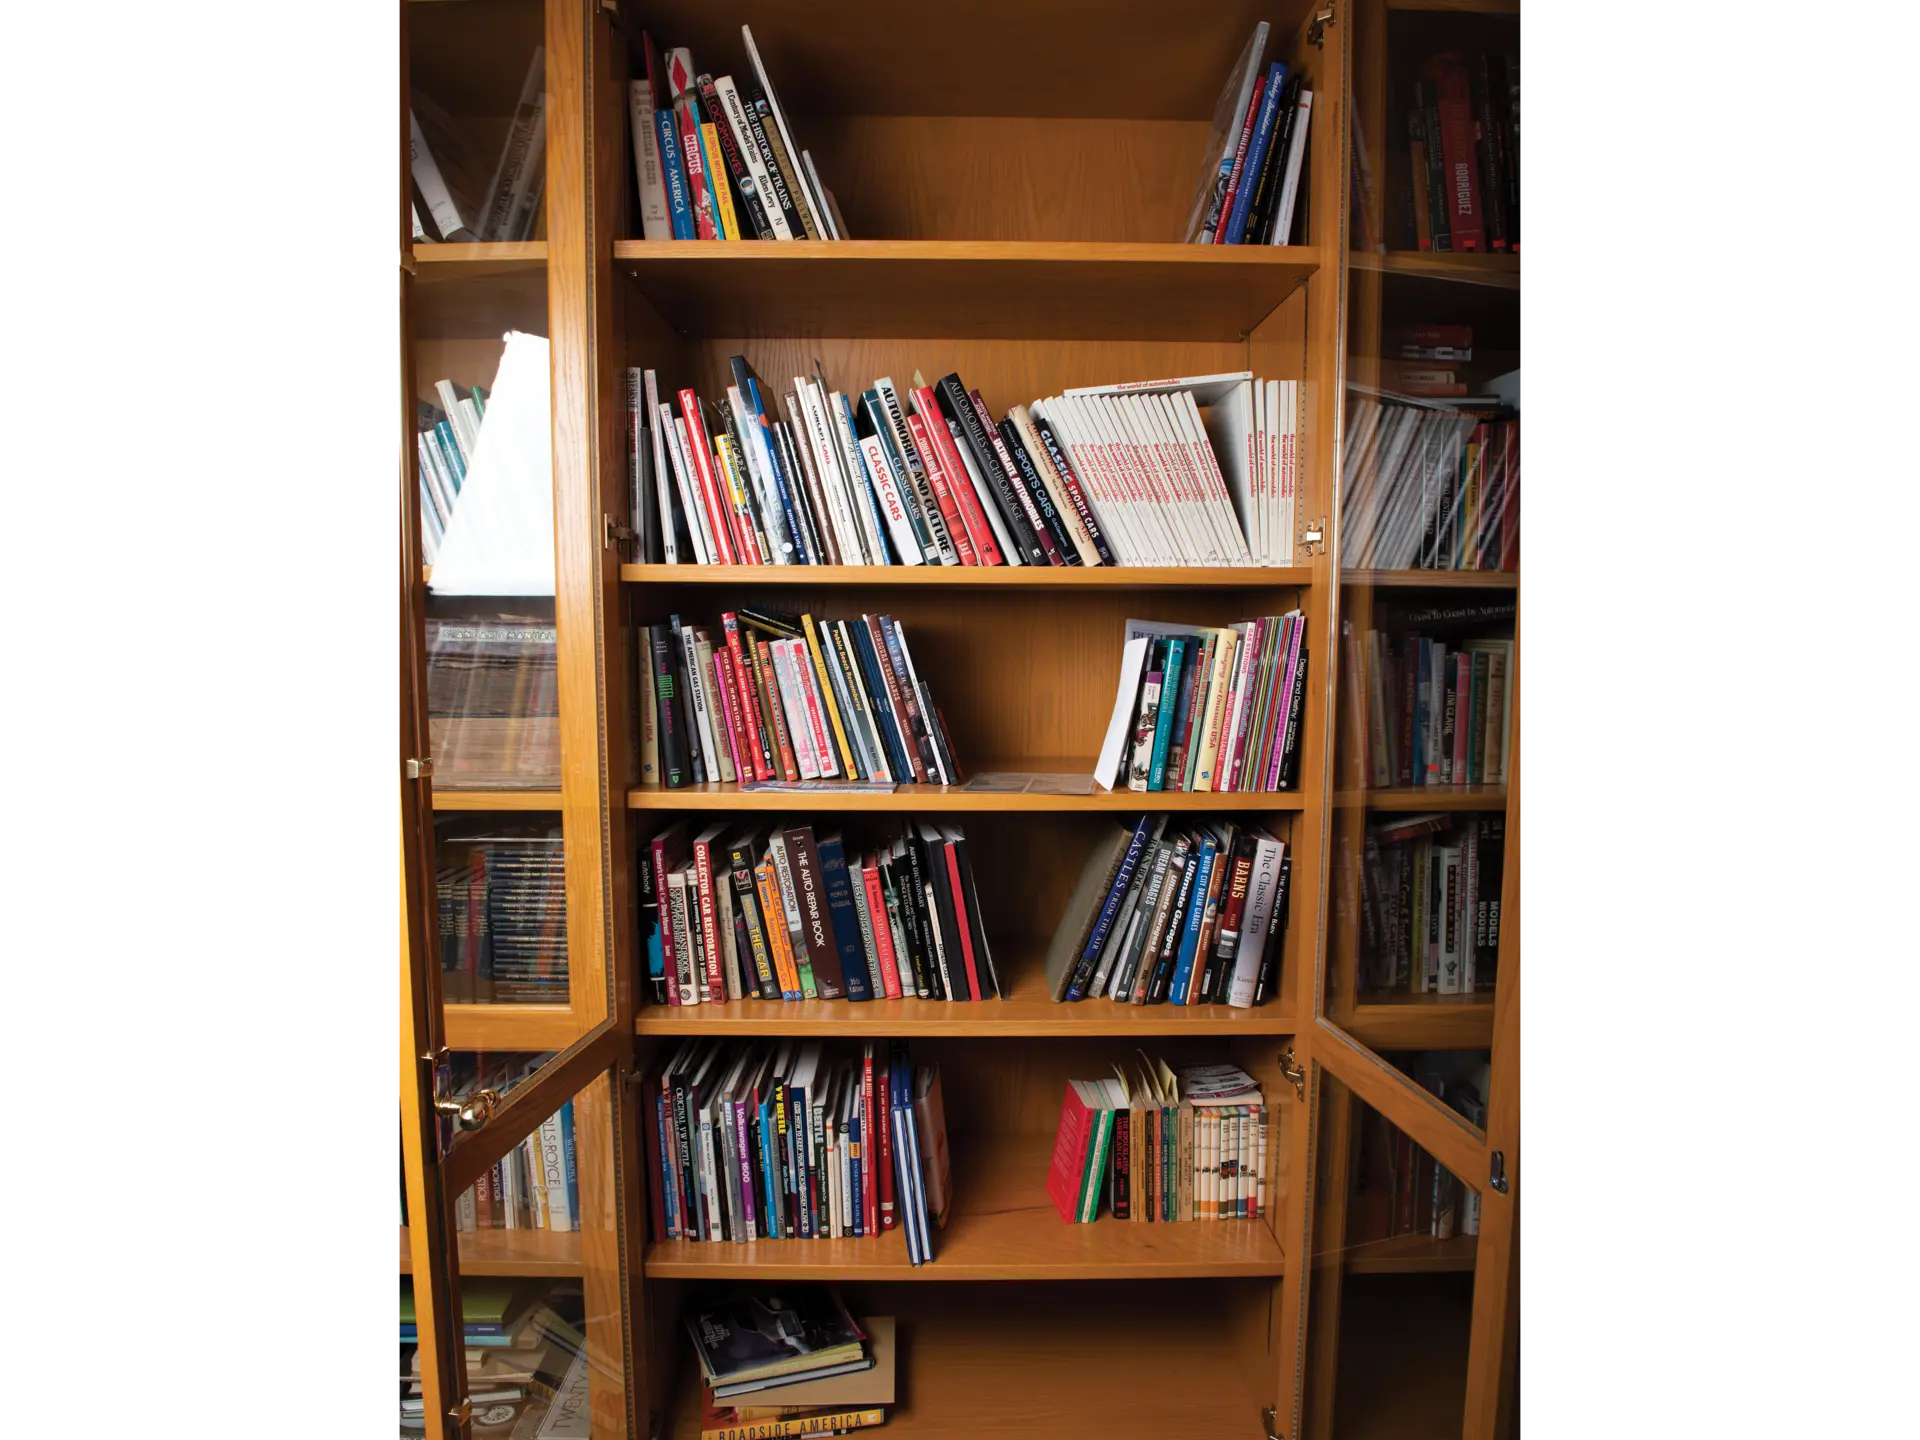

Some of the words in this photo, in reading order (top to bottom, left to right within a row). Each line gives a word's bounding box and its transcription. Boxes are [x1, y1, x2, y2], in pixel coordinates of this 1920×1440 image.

[726, 93, 742, 119] Century
[743, 101, 757, 123] THE
[706, 124, 714, 136] THE
[736, 117, 745, 126] of
[738, 124, 752, 145] Model
[706, 98, 743, 175] LOCOMOTIVES
[708, 136, 719, 159] CIRCUS
[751, 122, 773, 161] HISTORY
[661, 120, 675, 158] CIRCUS
[668, 167, 684, 213] AMERICA
[682, 133, 701, 175] CIRCUS
[746, 143, 760, 163] Trains
[766, 160, 778, 175] OF
[1226, 127, 1250, 193] HARLEY-DAVIDSON
[713, 159, 724, 181] MOVES
[758, 174, 770, 192] Allen
[718, 181, 726, 191] BY
[720, 191, 729, 204] RAIL
[763, 191, 776, 209] Levy
[771, 172, 792, 210] TRAINS
[1454, 162, 1472, 215] RODRÍGUEZ
[792, 189, 813, 232] PULLMAN
[1148, 379, 1180, 387] automobiles
[724, 416, 735, 438] Beauty
[811, 404, 824, 441] CONCEPT
[821, 443, 831, 464] CARS
[730, 438, 738, 446] of
[948, 379, 988, 448] AUTOMOBILES
[987, 458, 1015, 503] CHROME
[1008, 500, 1024, 520] AGE
[732, 446, 745, 471] CARS
[880, 384, 920, 468] AUTOMOBILE
[911, 468, 929, 496] AND
[922, 497, 951, 554] CULTURE
[867, 444, 891, 491] CLASSIC
[883, 490, 902, 521] CARS
[892, 456, 913, 497] CLASSIC
[907, 496, 921, 519] CARS
[991, 437, 1017, 477] ULTIMATE
[1010, 475, 1044, 531] AUTOMOBILES
[1013, 446, 1040, 489] SPORTS
[1034, 488, 1055, 518] CARS
[1039, 428, 1072, 484] CLASSIC
[1067, 484, 1088, 516] SPORTS
[1083, 516, 1099, 538] CARS
[786, 508, 798, 534] Aventura
[793, 535, 801, 548] Port
[508, 630, 554, 640] MANUAL
[884, 624, 898, 654] PEBBLE
[894, 655, 908, 683] BEACH
[1218, 640, 1233, 678] Amazing
[1241, 643, 1251, 674] STATIONS
[686, 646, 697, 676] AMERICAN
[694, 688, 703, 711] STATION
[832, 628, 843, 650] Pebble
[839, 650, 850, 671] Beach
[845, 670, 862, 711] Remembered
[658, 674, 673, 699] MOTEL
[722, 651, 732, 684] MOBILE
[729, 687, 742, 732] MANSIONS
[745, 666, 757, 695] Roadside
[751, 696, 764, 727] Memories
[1446, 688, 1454, 705] JIM
[1211, 694, 1223, 729] Unusual
[1445, 706, 1453, 733] CLARK
[1208, 730, 1217, 748] USA
[775, 844, 786, 864] AUTO
[796, 851, 808, 866] THE
[908, 846, 917, 865] AUTO
[1115, 829, 1146, 890] CASTLES
[1141, 837, 1158, 866] BARN
[1154, 848, 1171, 874] DREAM
[1201, 854, 1211, 874] MOTOR
[1261, 846, 1276, 869] The
[640, 860, 650, 894] autobody
[696, 844, 709, 895] COLLECTOR
[800, 867, 813, 891] AUTO
[1130, 866, 1147, 892] BOOK
[1176, 859, 1196, 908] Ultimate
[1198, 874, 1207, 886] CITY
[1230, 860, 1250, 898] BARNS
[780, 864, 796, 912] RESTORATION
[912, 866, 924, 908] DICTIONARY
[1144, 873, 1163, 906] GARAGES
[1161, 874, 1177, 910] Ultimate
[1195, 887, 1205, 905] DREAM
[1253, 871, 1271, 912] Classic
[675, 887, 685, 929] COMPLETE
[701, 896, 711, 914] CAR
[805, 891, 819, 919] REPAIR
[1105, 891, 1120, 915] FROM
[1272, 887, 1283, 918] AMERICAN
[811, 920, 825, 946] BOOK
[1098, 916, 1110, 934] THE
[1150, 911, 1166, 945] Garages
[1161, 908, 1182, 956] Garages
[1190, 906, 1201, 931] GARAGES
[1248, 914, 1263, 935] Era
[1268, 918, 1277, 934] BARN
[1477, 901, 1487, 947] MODELS
[1488, 901, 1498, 946] MODELS
[703, 916, 717, 975] RESTORATION
[852, 880, 868, 928] RESTORING
[861, 928, 880, 989] CONVERTIBLES
[1091, 935, 1102, 950] AIR
[679, 930, 689, 973] HANDBOOK
[748, 926, 762, 950] THE
[755, 952, 769, 977] CAR
[675, 1087, 685, 1124] ORIGINAL
[774, 1085, 782, 1101] VW
[724, 1101, 732, 1125] BEETLE
[776, 1102, 785, 1134] BEETLE
[814, 1107, 825, 1143] BEETLE
[679, 1127, 687, 1139] VW
[735, 1107, 747, 1158] Volkswagen
[741, 1161, 749, 1182] 1600
[680, 1141, 689, 1166] BEETLE
[719, 1422, 790, 1440] ROADSIDE
[800, 1413, 863, 1433] AMERICA
